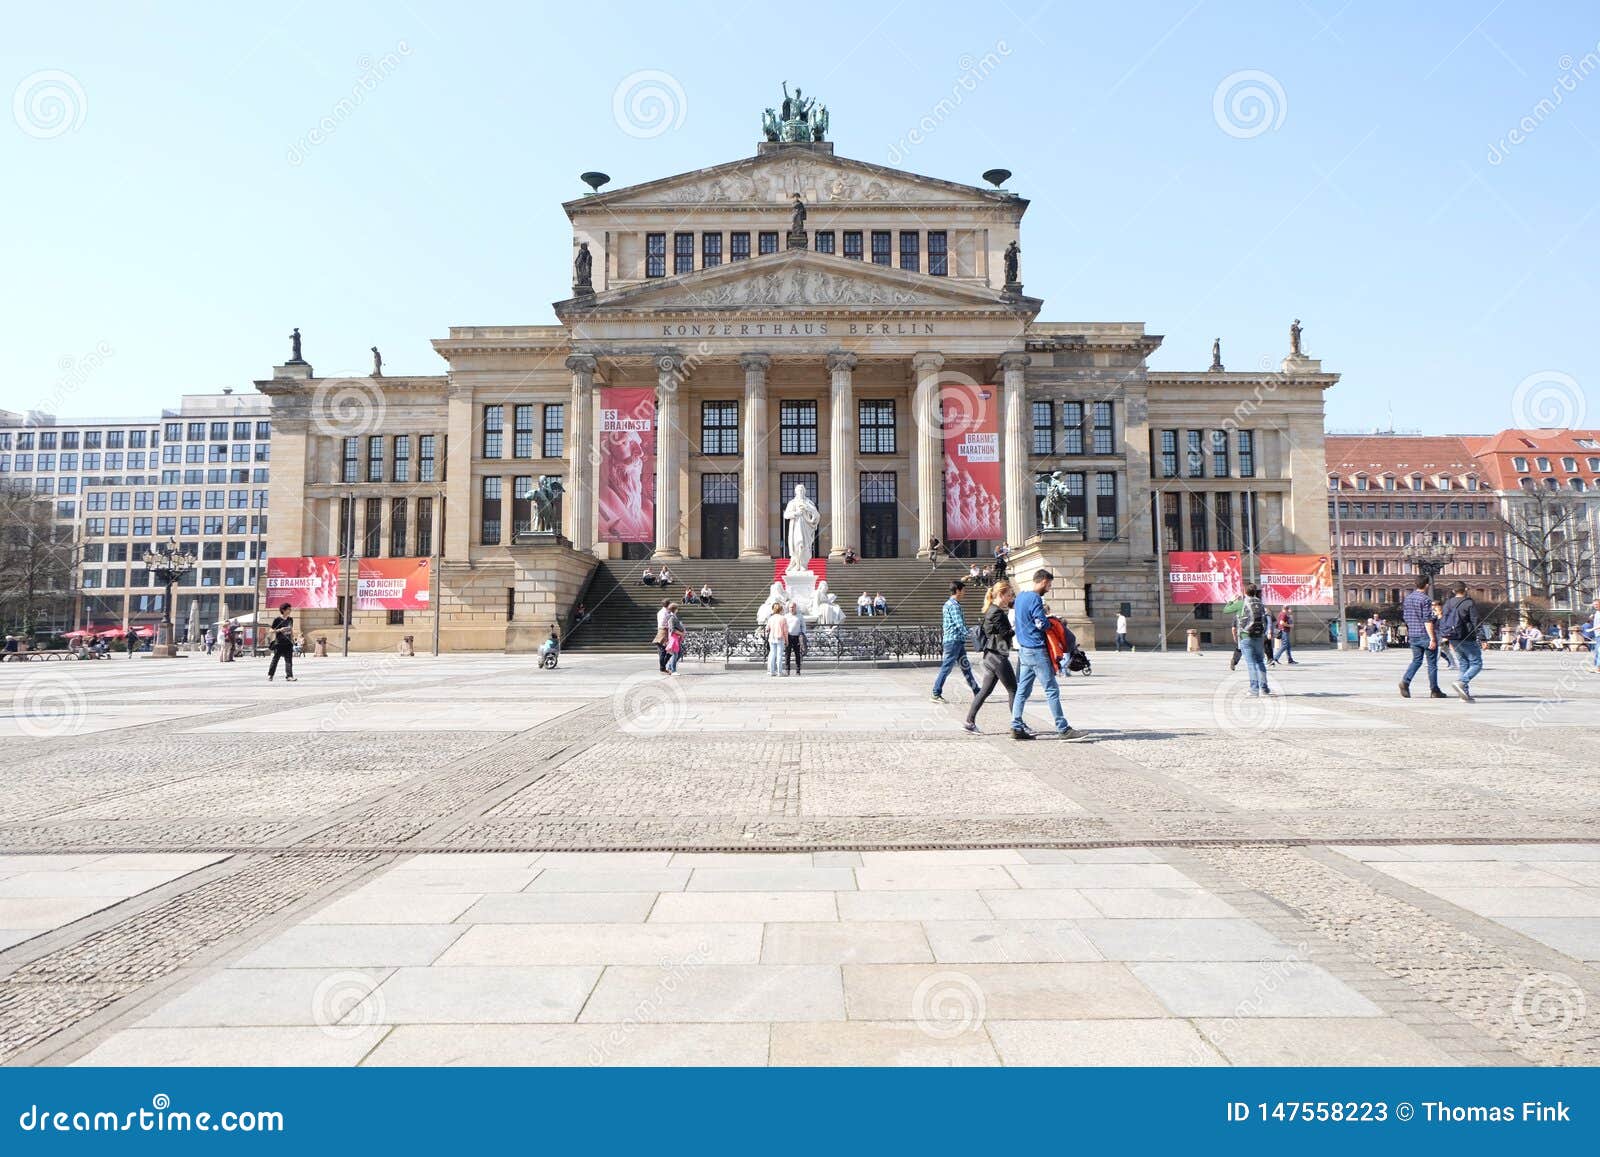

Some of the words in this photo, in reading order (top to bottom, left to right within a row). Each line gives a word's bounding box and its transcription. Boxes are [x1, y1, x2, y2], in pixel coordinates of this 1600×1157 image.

[662, 324, 829, 336] KONZERTHAUS
[849, 324, 935, 335] BERLIN
[604, 410, 616, 420] ES
[604, 421, 648, 430] BRAHMST.
[960, 445, 995, 455] MARATHON
[1171, 574, 1180, 582] ES
[268, 579, 278, 587] ES
[366, 580, 376, 588] SO
